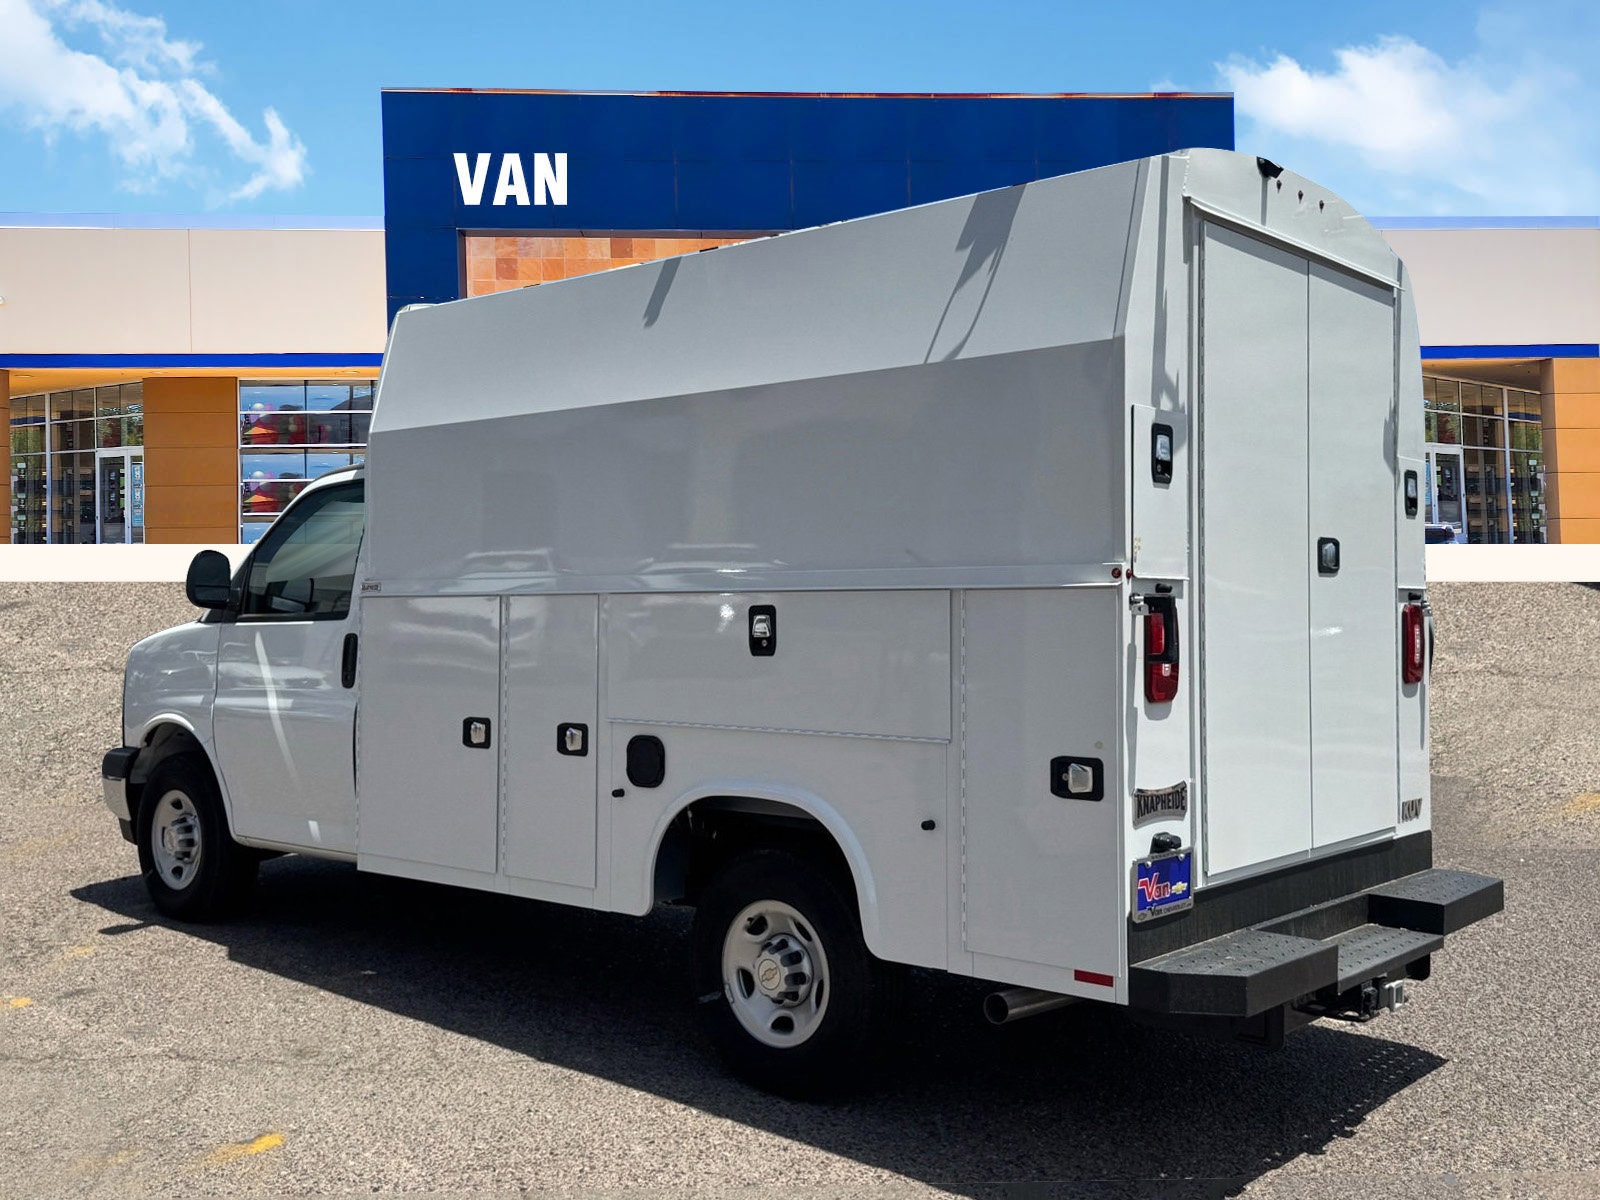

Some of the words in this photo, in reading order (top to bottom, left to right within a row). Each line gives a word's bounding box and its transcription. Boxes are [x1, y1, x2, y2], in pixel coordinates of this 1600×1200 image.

[453, 153, 567, 205] VAN
[1137, 789, 1187, 819] KNAPHEIDE
[1138, 872, 1171, 901] Van
